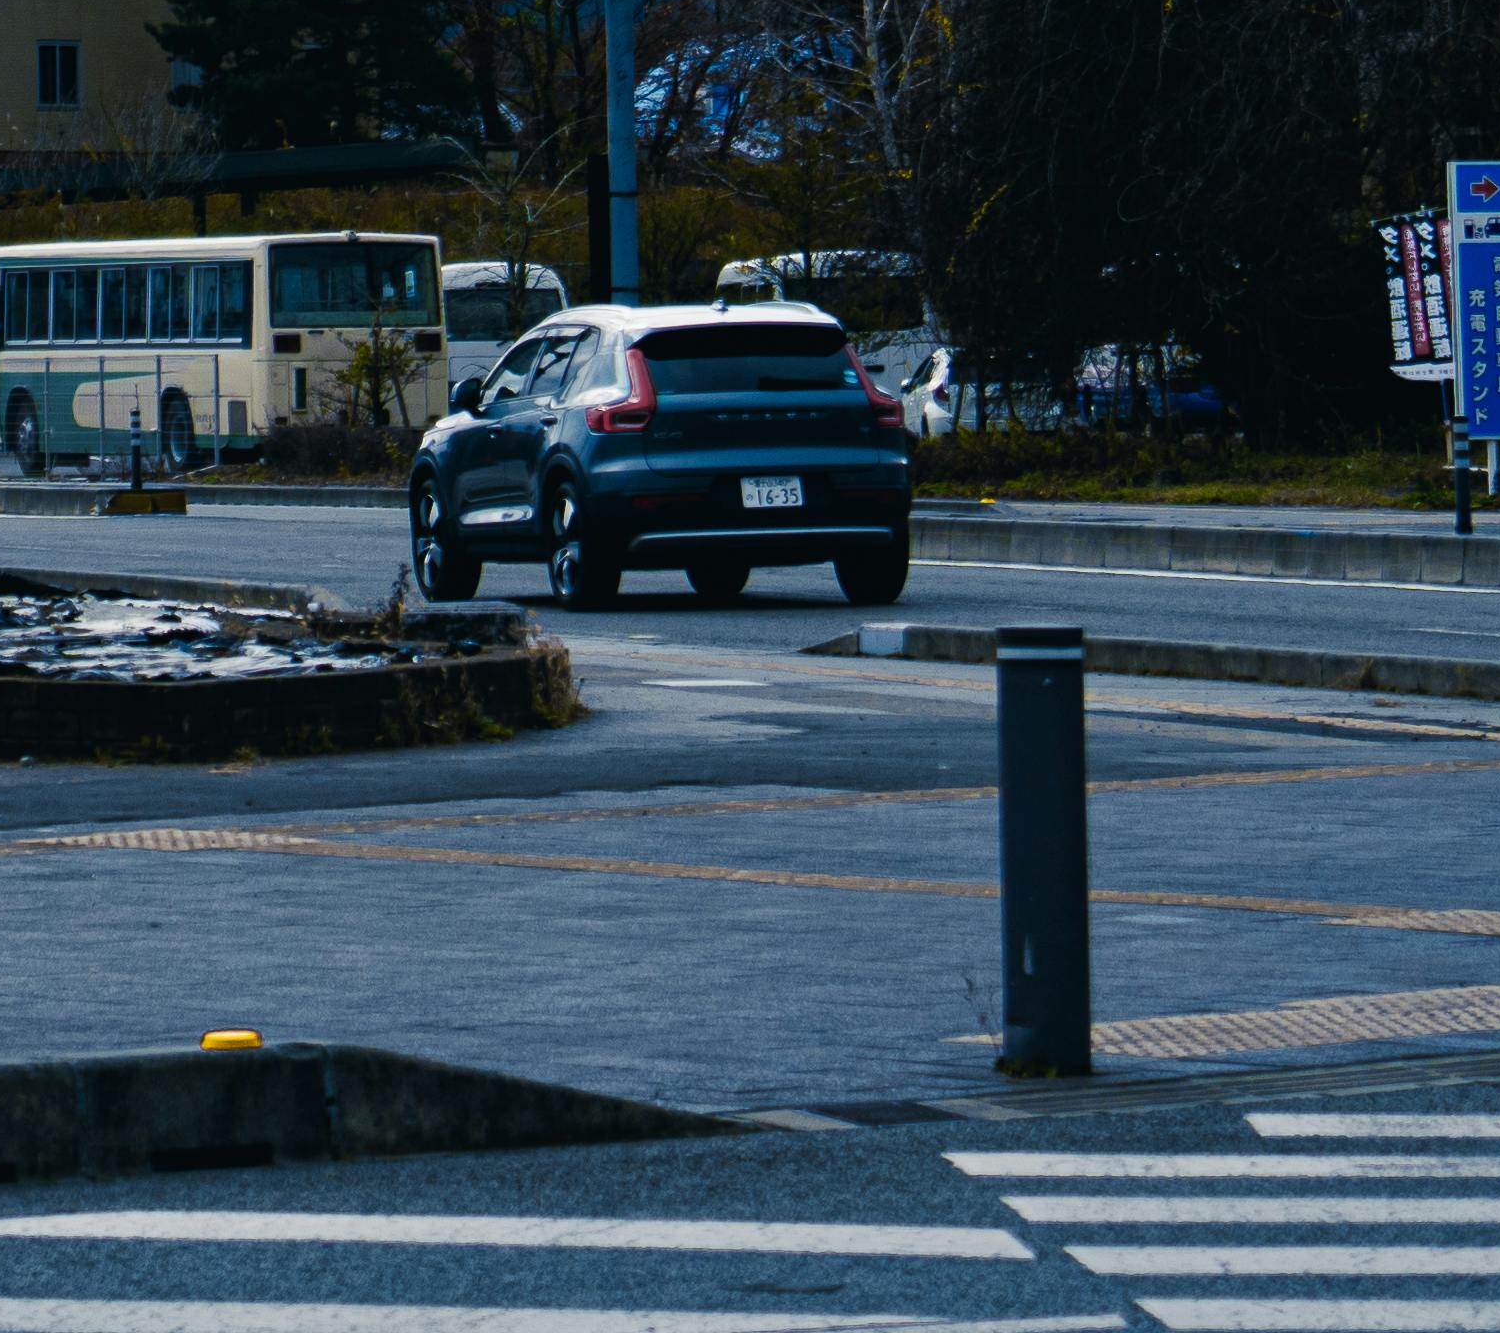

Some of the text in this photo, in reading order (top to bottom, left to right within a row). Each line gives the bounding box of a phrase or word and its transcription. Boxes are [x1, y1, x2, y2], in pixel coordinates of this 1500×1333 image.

[1468, 290, 1490, 426] 充電スタンド
[757, 488, 798, 505] 16-35
